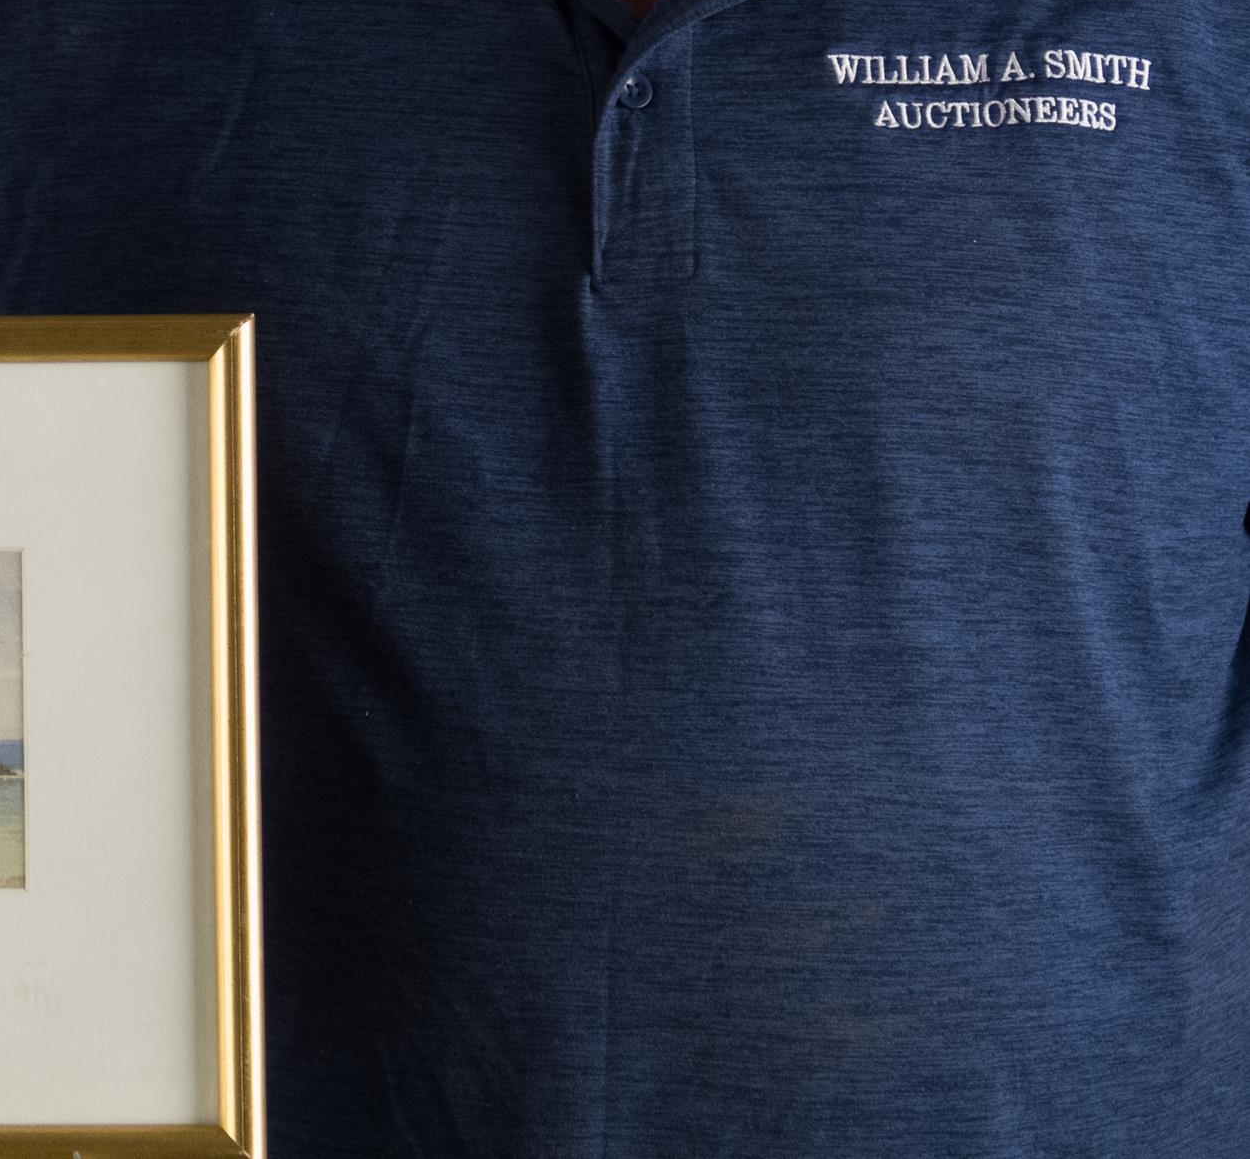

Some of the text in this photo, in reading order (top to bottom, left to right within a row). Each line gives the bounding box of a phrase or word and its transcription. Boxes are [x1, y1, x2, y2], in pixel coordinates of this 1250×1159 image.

[827, 49, 1152, 90] WILLIAM A. SMITH
[873, 97, 1117, 131] AUCTIONEERS
